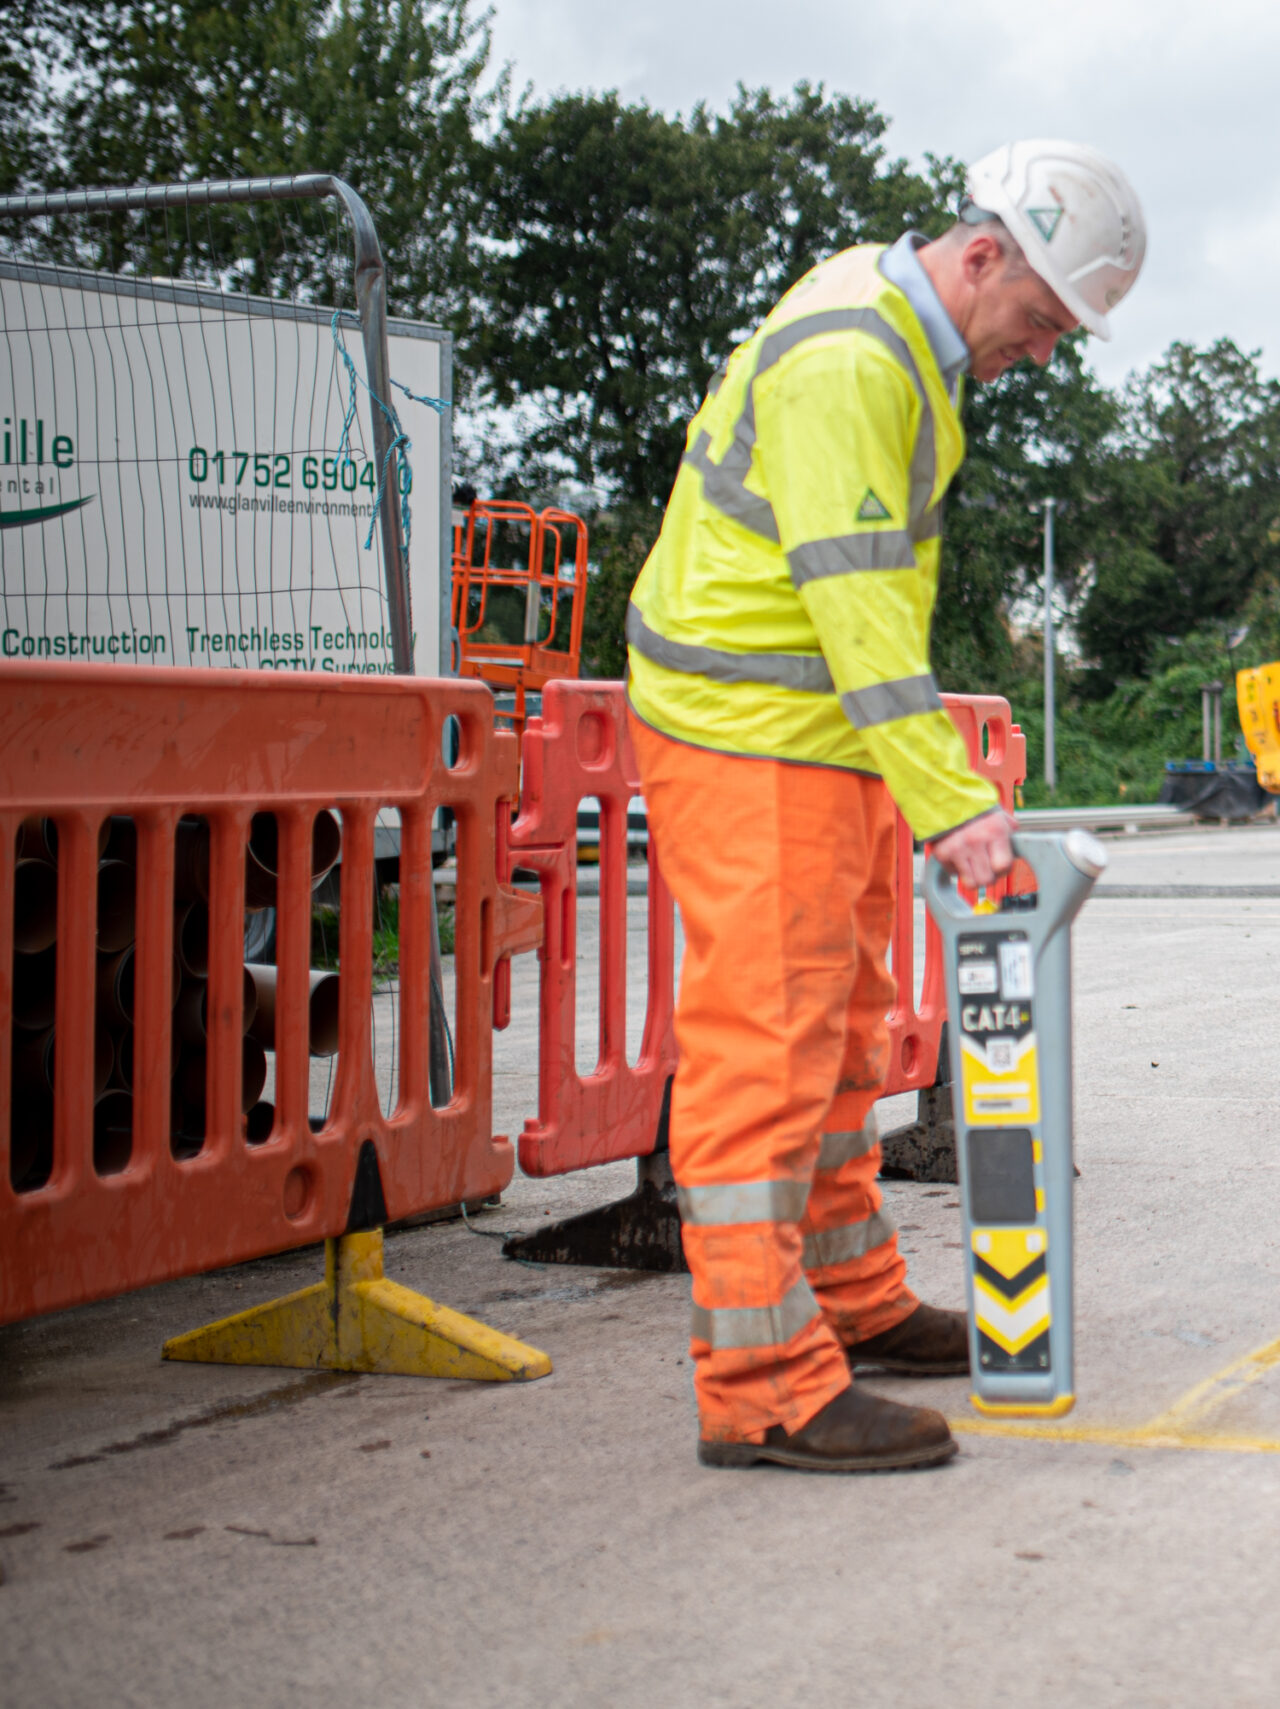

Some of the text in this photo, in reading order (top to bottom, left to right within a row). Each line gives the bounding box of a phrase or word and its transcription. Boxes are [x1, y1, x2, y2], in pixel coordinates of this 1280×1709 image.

[189, 447, 413, 494] 01752 69040
[0, 476, 55, 495] ntal
[2, 628, 166, 656] Construction
[187, 626, 417, 652] Trenchless Technolo
